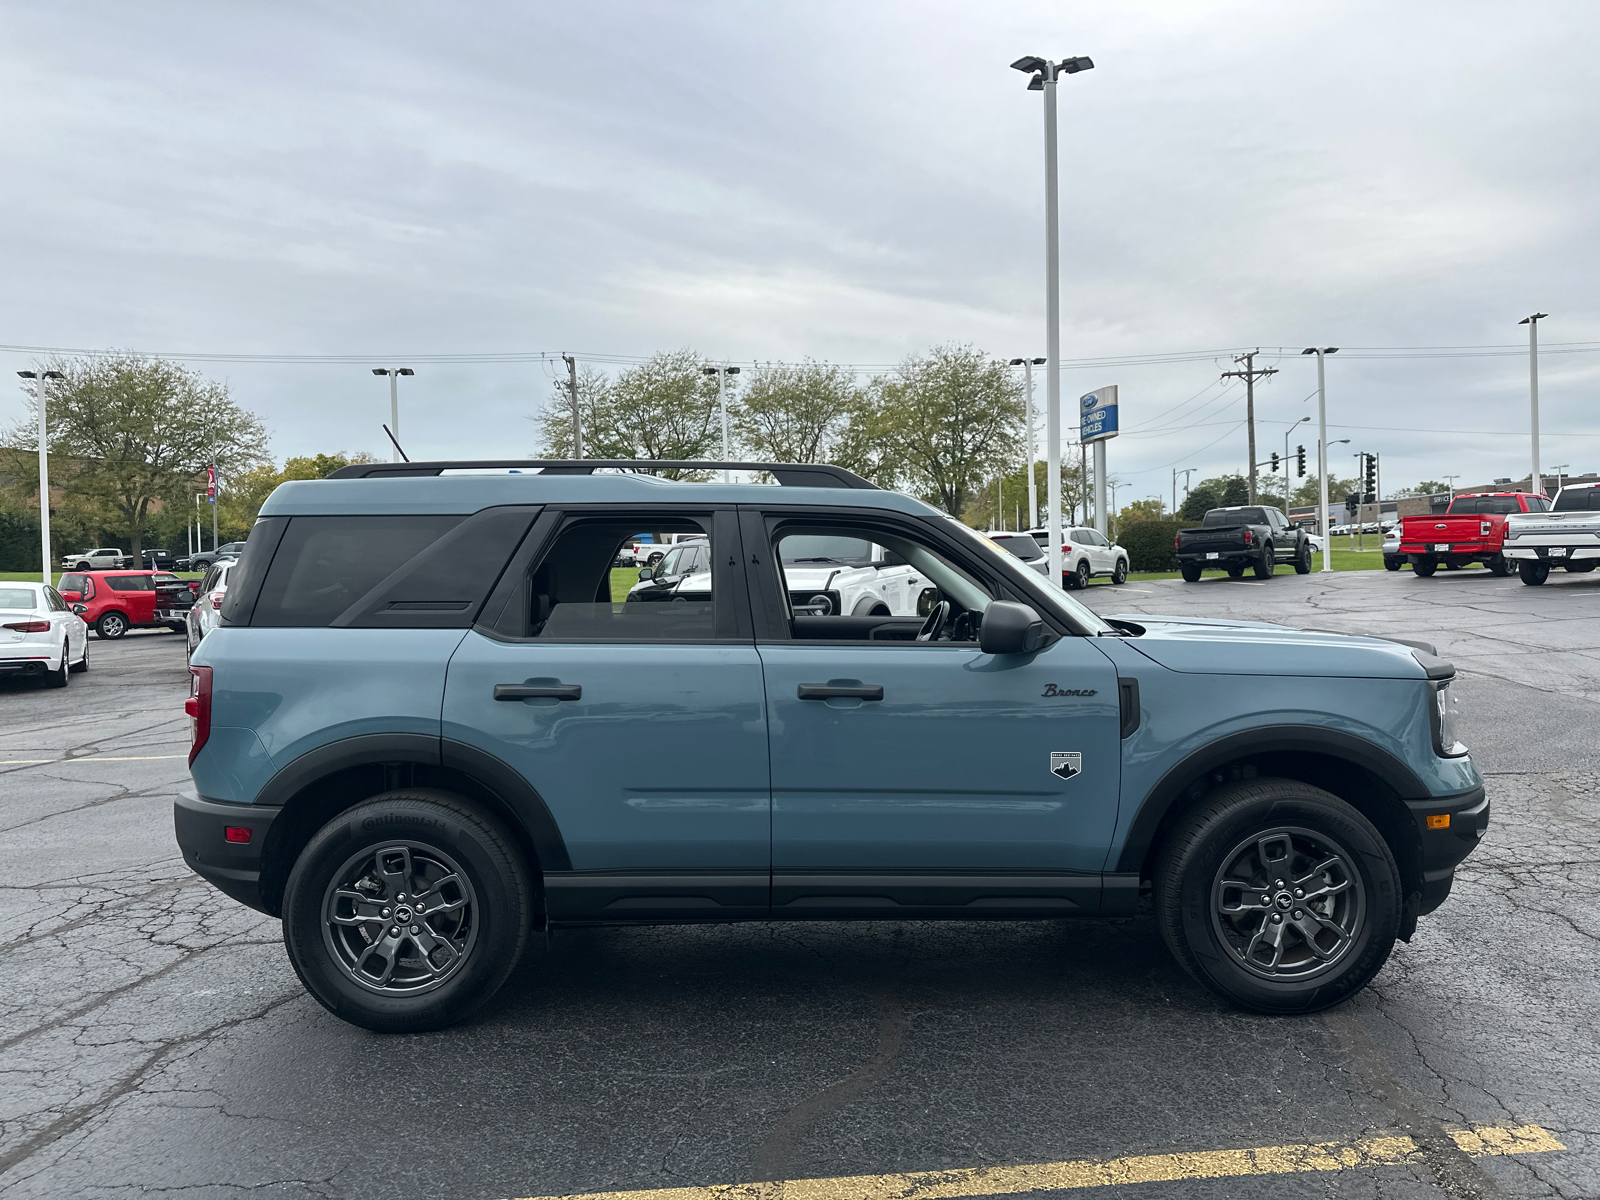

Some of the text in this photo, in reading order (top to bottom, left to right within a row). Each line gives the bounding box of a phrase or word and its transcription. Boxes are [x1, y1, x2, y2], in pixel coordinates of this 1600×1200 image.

[1181, 533, 1242, 541] FORD
[1040, 683, 1098, 697] Bronco
[361, 812, 439, 831] Continental
